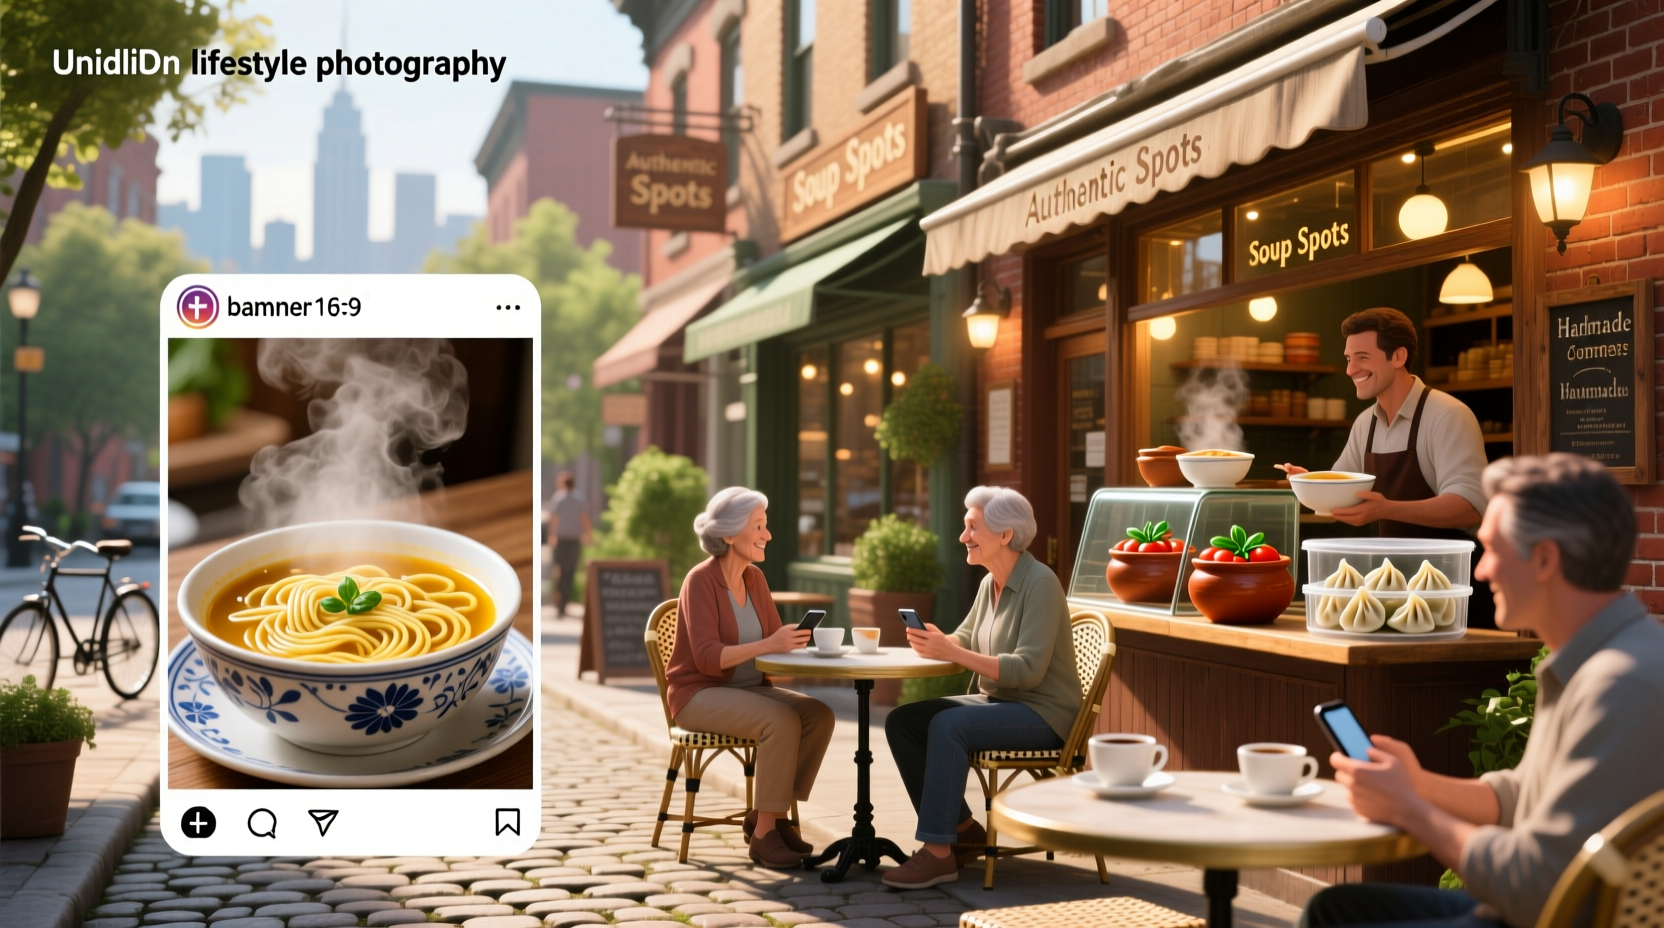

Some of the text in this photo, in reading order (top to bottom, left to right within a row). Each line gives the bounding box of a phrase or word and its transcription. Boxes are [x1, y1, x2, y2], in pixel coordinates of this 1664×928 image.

[629, 173, 714, 216] Spots
[791, 121, 907, 213] Soup Spots
[1025, 133, 1203, 228] Authentic Spots
[1249, 221, 1350, 268] Soup Spots
